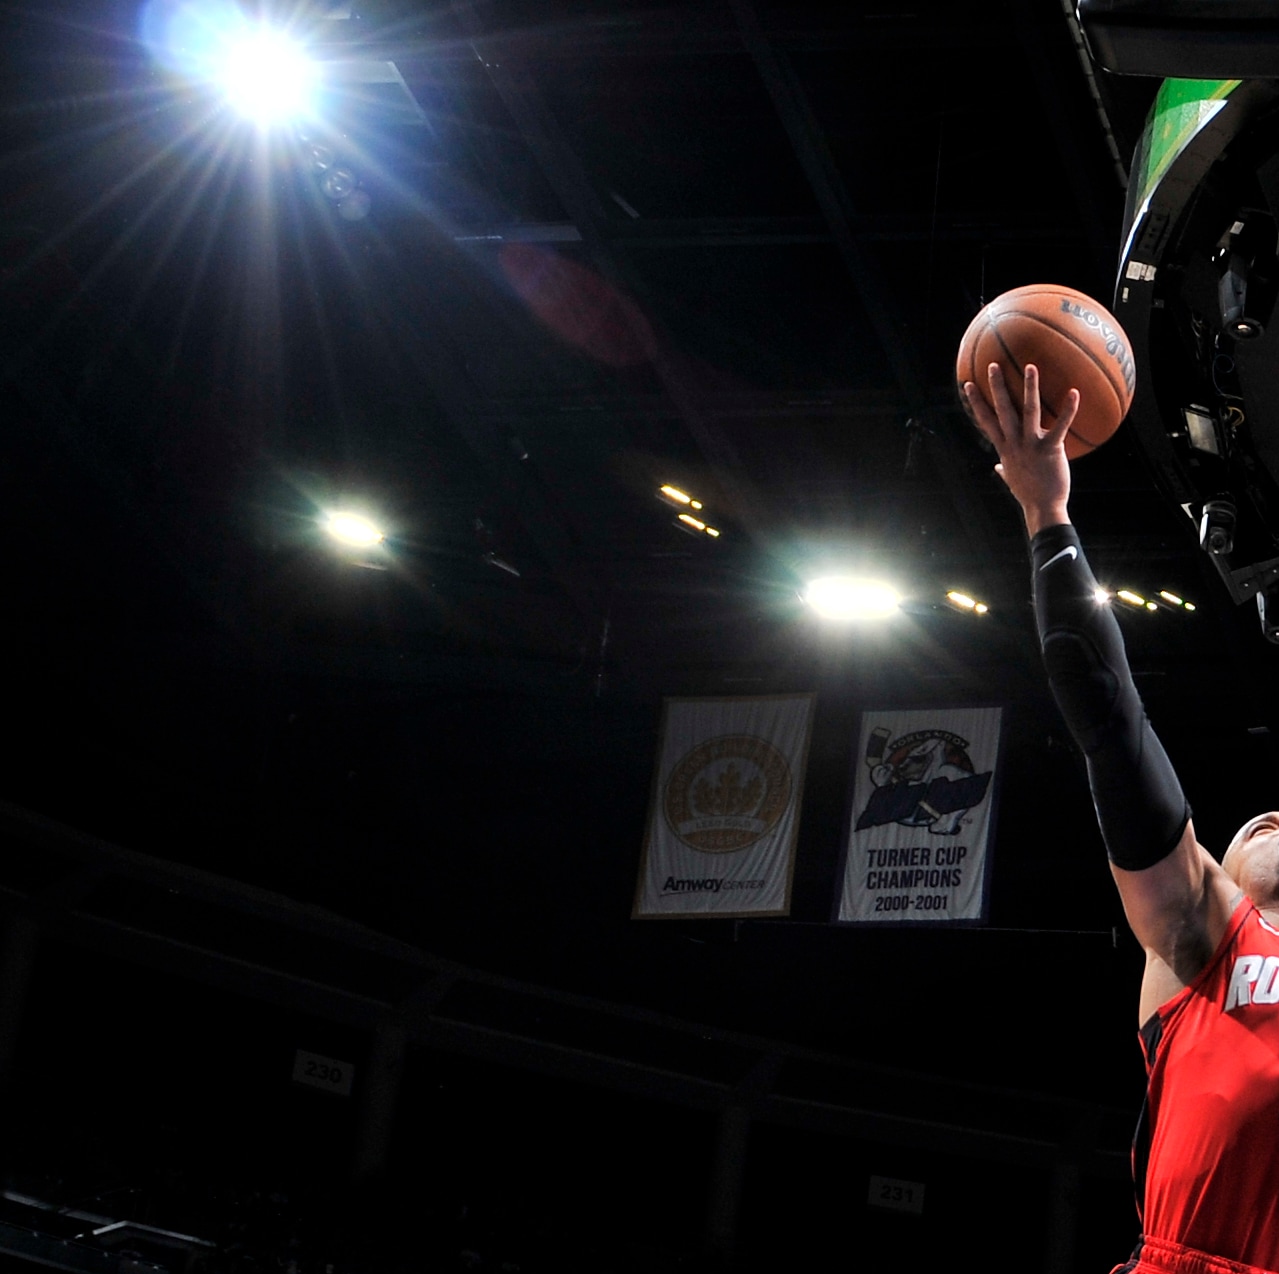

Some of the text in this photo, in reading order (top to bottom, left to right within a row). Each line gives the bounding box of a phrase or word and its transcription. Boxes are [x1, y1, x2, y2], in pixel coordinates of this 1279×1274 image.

[898, 731, 962, 747] ORLANDO
[867, 847, 967, 868] TURNER CUP
[663, 876, 765, 893] Amway CENTER
[866, 869, 961, 890] CHAMPIONS
[875, 895, 948, 912] 2000-2001
[305, 1061, 341, 1083] 230
[881, 1185, 913, 1203] 231
